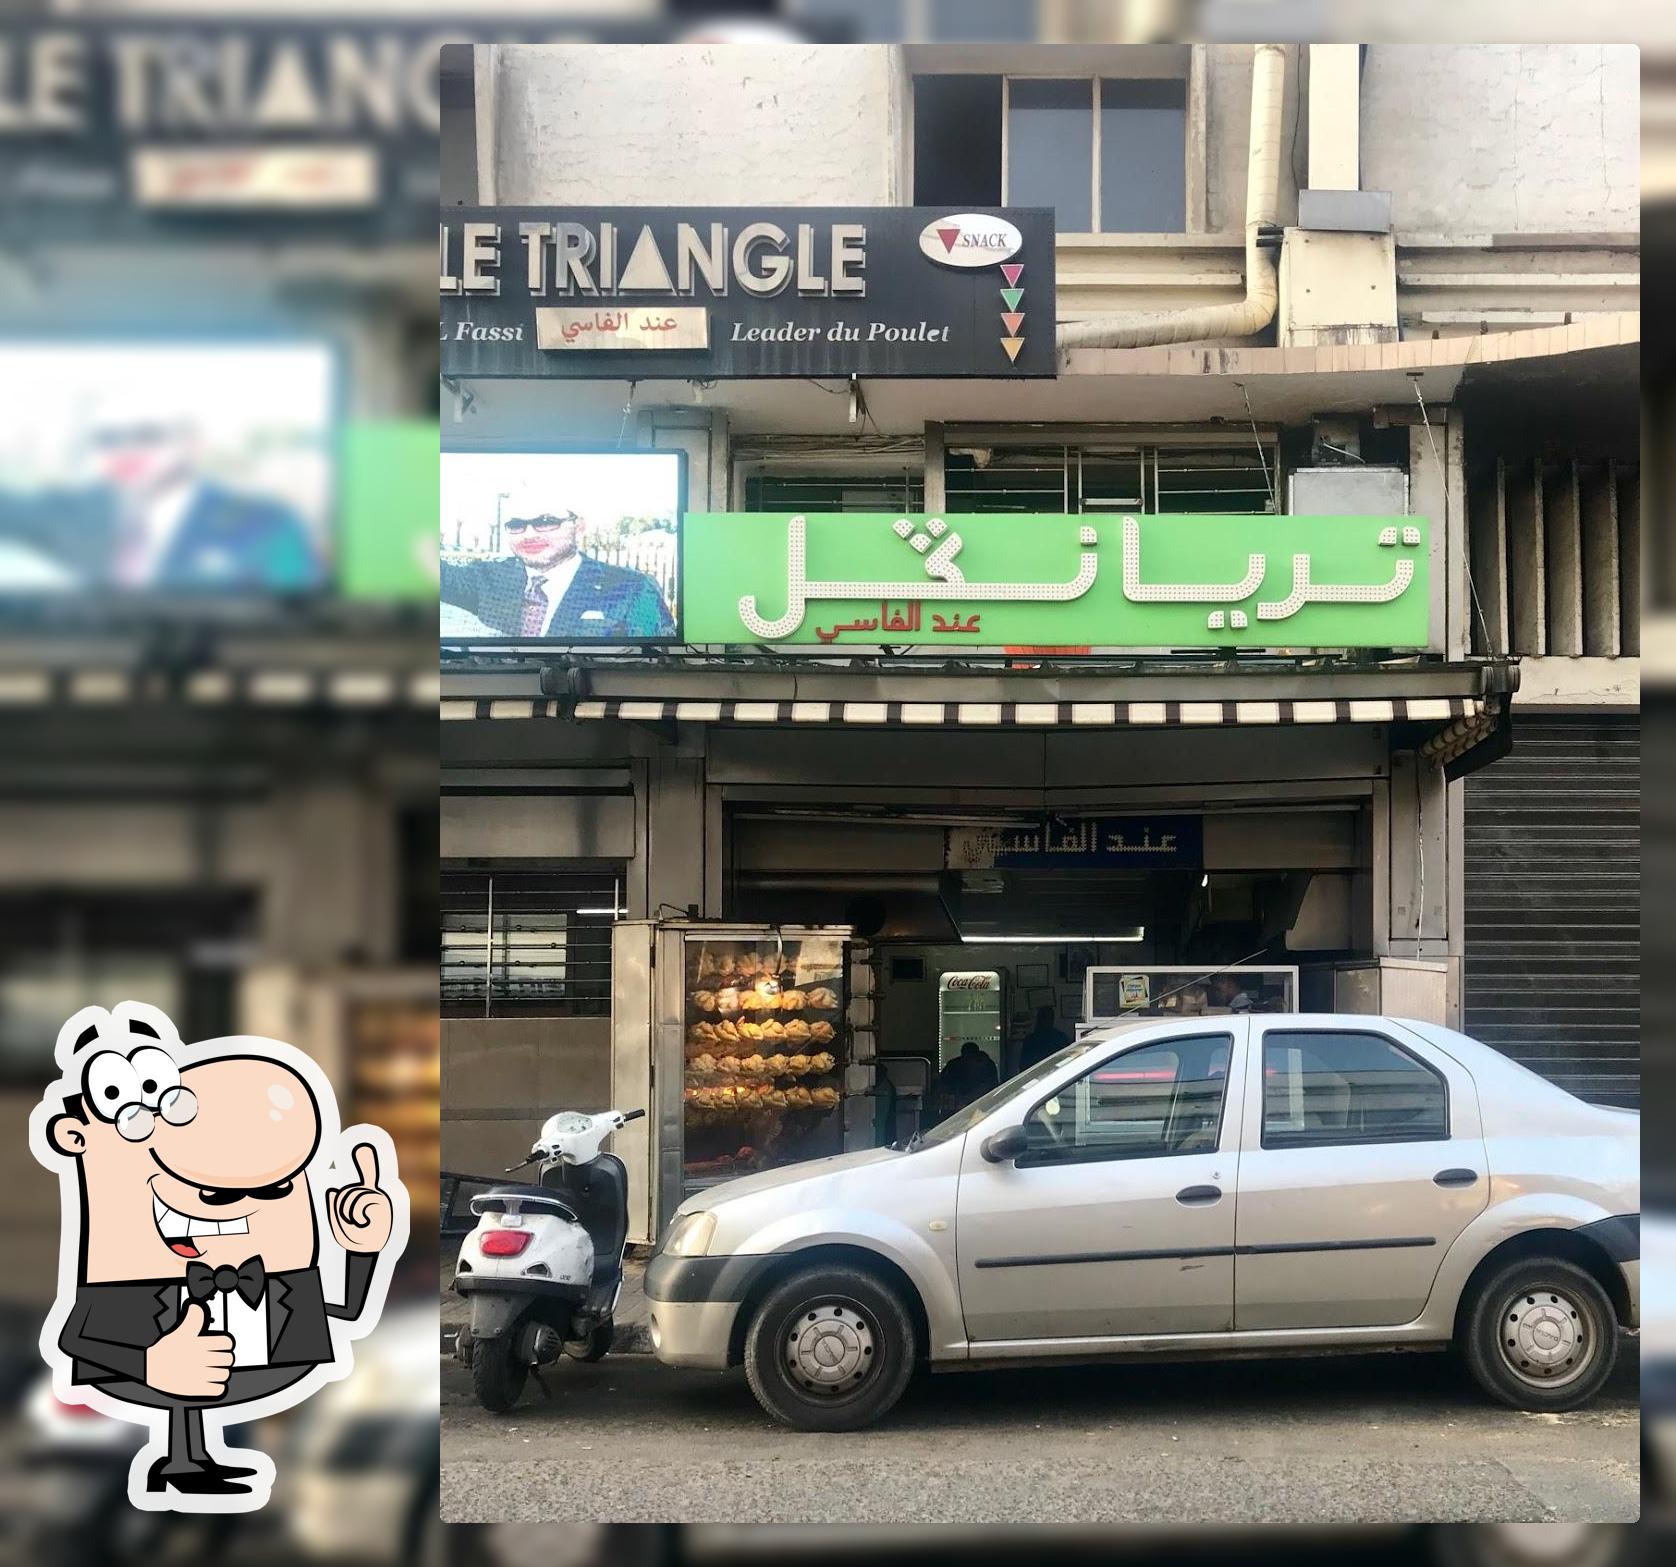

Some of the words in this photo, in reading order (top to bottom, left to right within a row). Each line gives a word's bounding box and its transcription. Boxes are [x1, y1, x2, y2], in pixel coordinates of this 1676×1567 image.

[962, 233, 1008, 248] SNACK
[440, 222, 501, 296] LE
[518, 222, 866, 297] TRIANGLE
[453, 321, 524, 341] Fassi
[561, 312, 629, 344] الفاسي
[640, 315, 678, 332] عند
[730, 321, 821, 342] Leader
[827, 321, 861, 342] du
[866, 321, 949, 342] Poulet
[815, 599, 921, 645] الفاسي
[932, 613, 981, 632] عند
